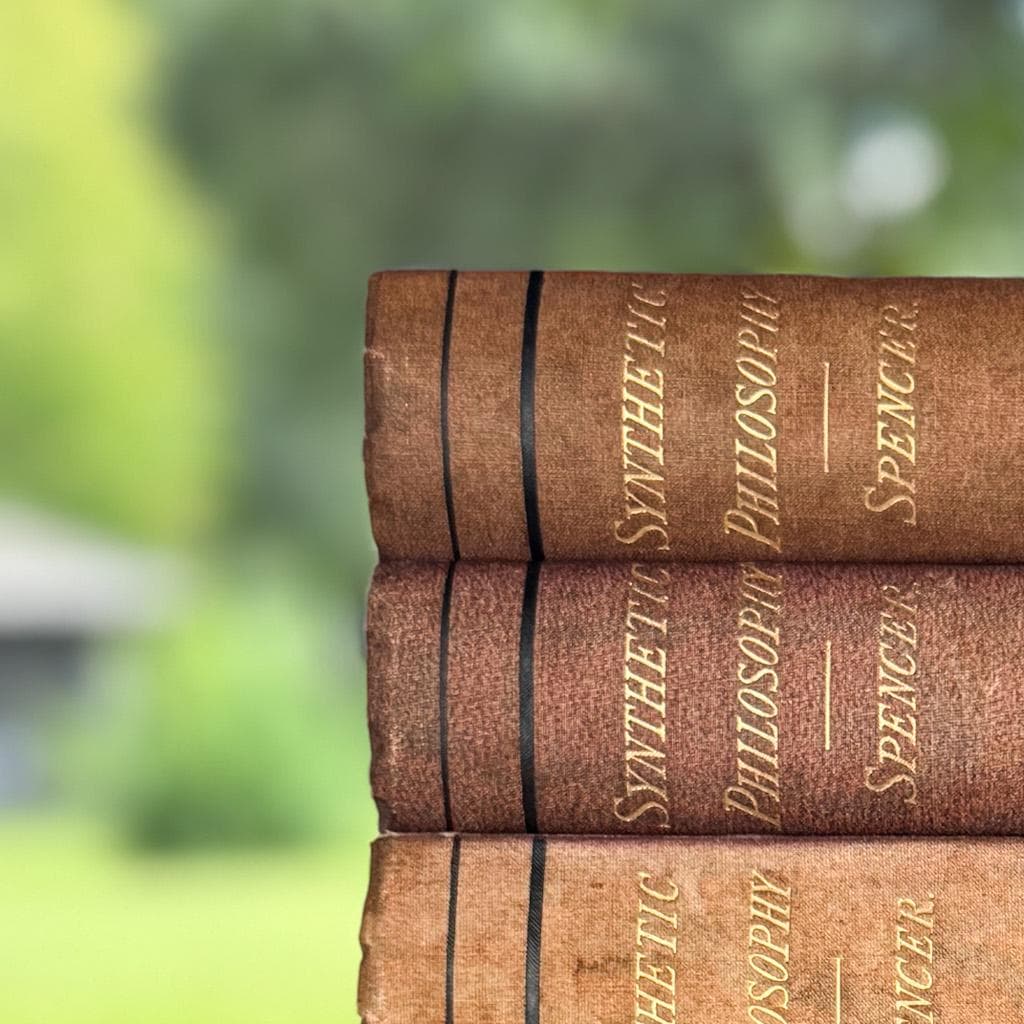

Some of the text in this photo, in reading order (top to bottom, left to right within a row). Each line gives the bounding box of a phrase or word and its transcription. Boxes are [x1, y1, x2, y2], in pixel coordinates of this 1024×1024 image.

[614, 282, 670, 551] SYNTHETIC
[724, 289, 781, 553] PHILOSOPHY
[614, 563, 670, 829] SYNTHETIC
[724, 563, 782, 830] PHILOSOPHY
